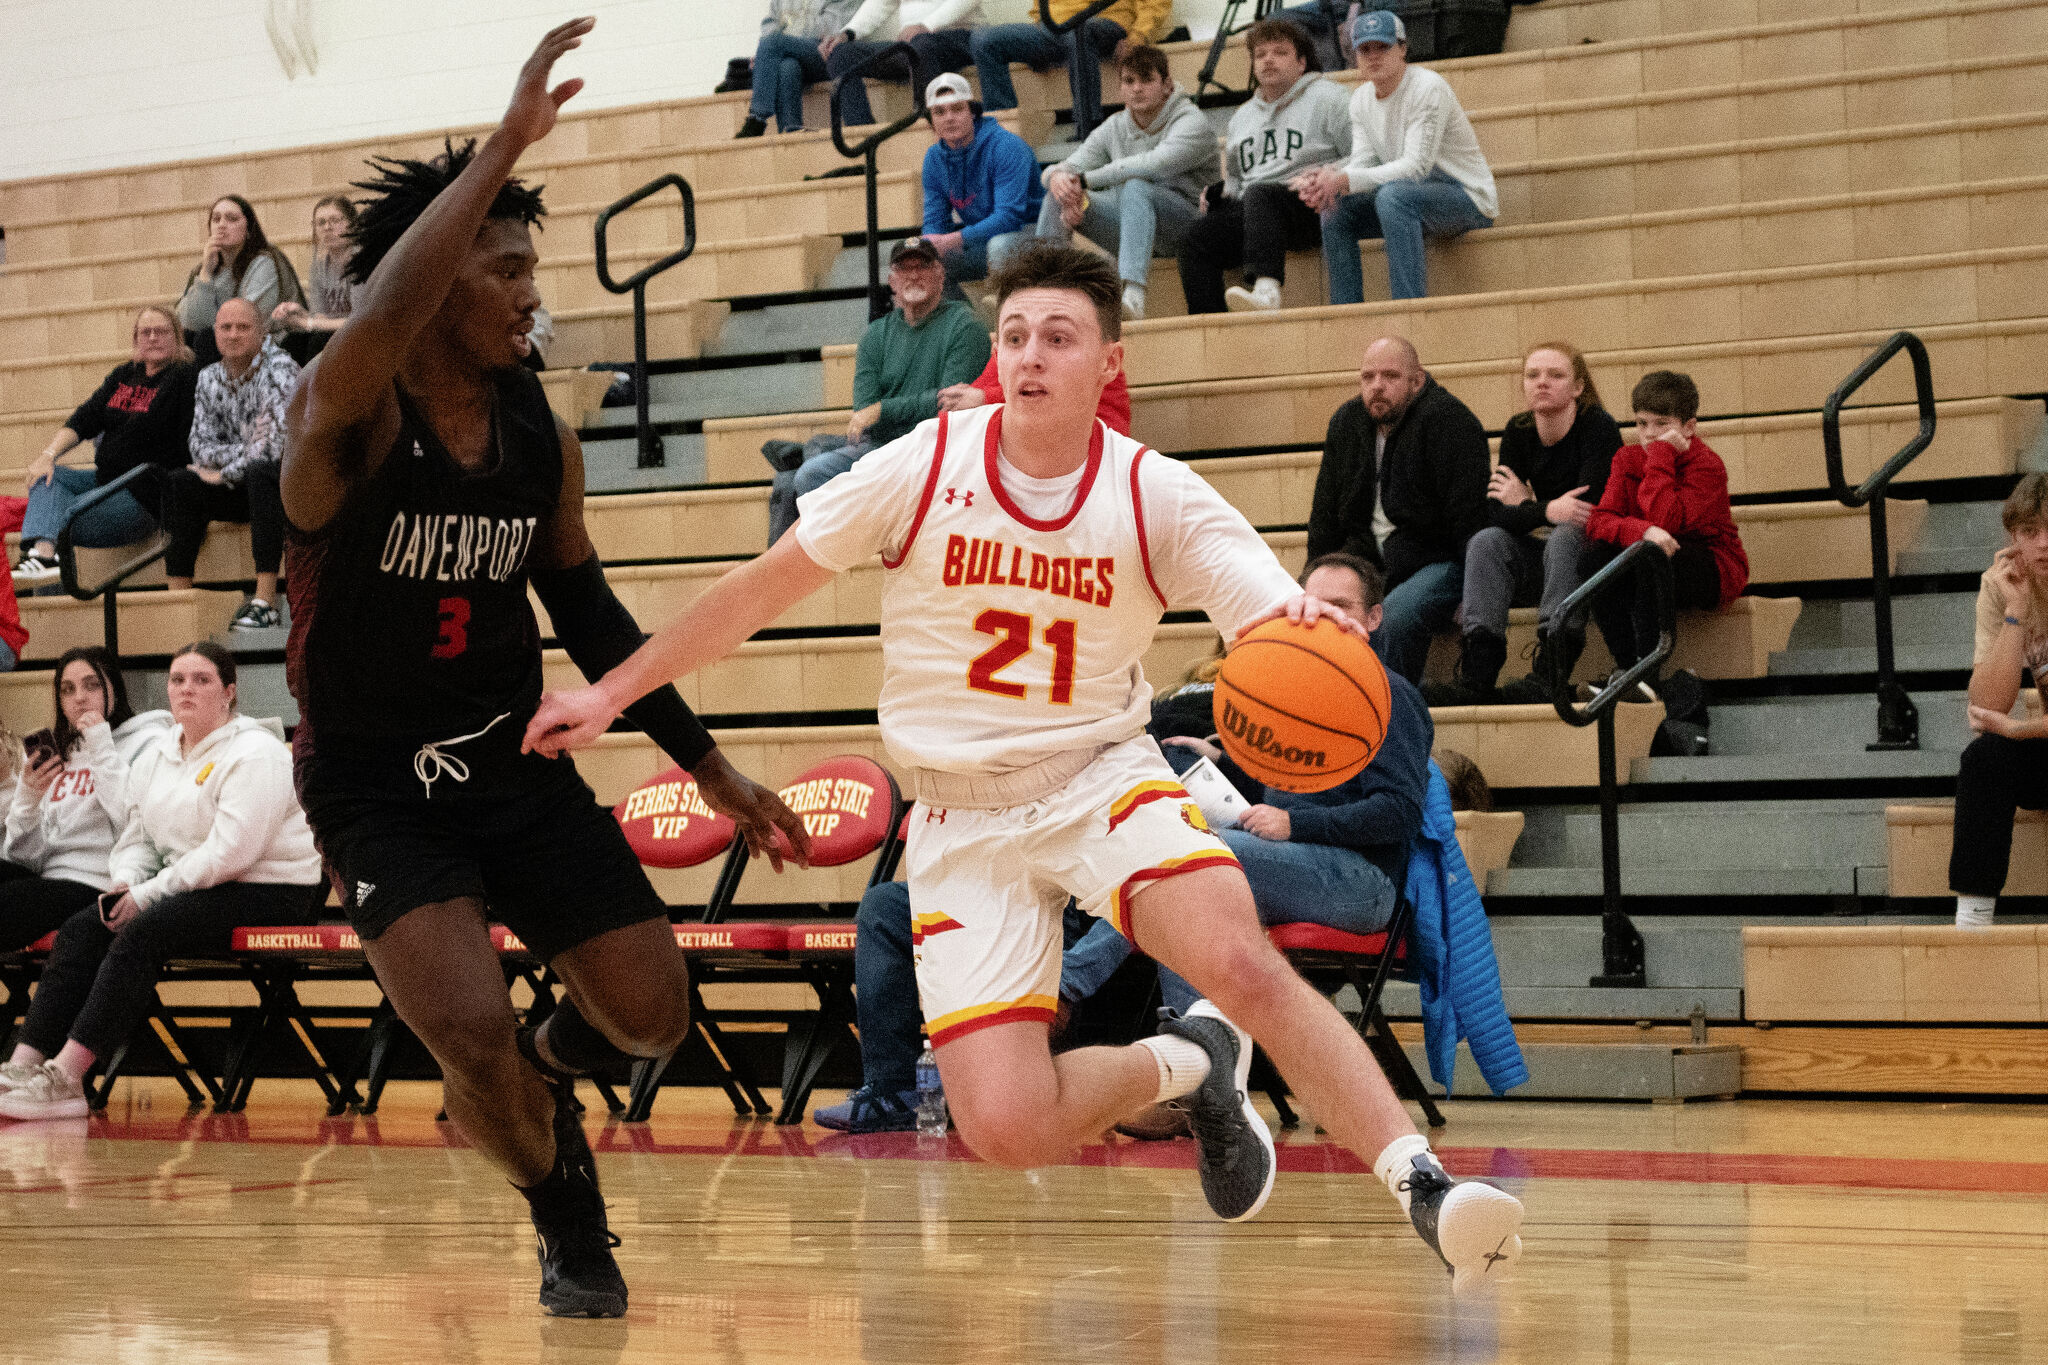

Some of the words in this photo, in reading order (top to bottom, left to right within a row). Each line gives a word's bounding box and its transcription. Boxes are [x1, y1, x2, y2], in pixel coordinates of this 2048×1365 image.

[1240, 128, 1303, 173] GAP
[379, 511, 537, 583] DAVENPORT
[942, 534, 1114, 608] BULLDOGS
[431, 597, 471, 658] 3
[967, 607, 1078, 706] 21
[1222, 698, 1328, 767] Wilson
[622, 781, 682, 823] FERRIS
[830, 778, 875, 819] STATE
[652, 816, 689, 839] VIP
[803, 814, 840, 837] VIP
[247, 934, 323, 948] BASKETBALL
[676, 932, 734, 947] KETBALL
